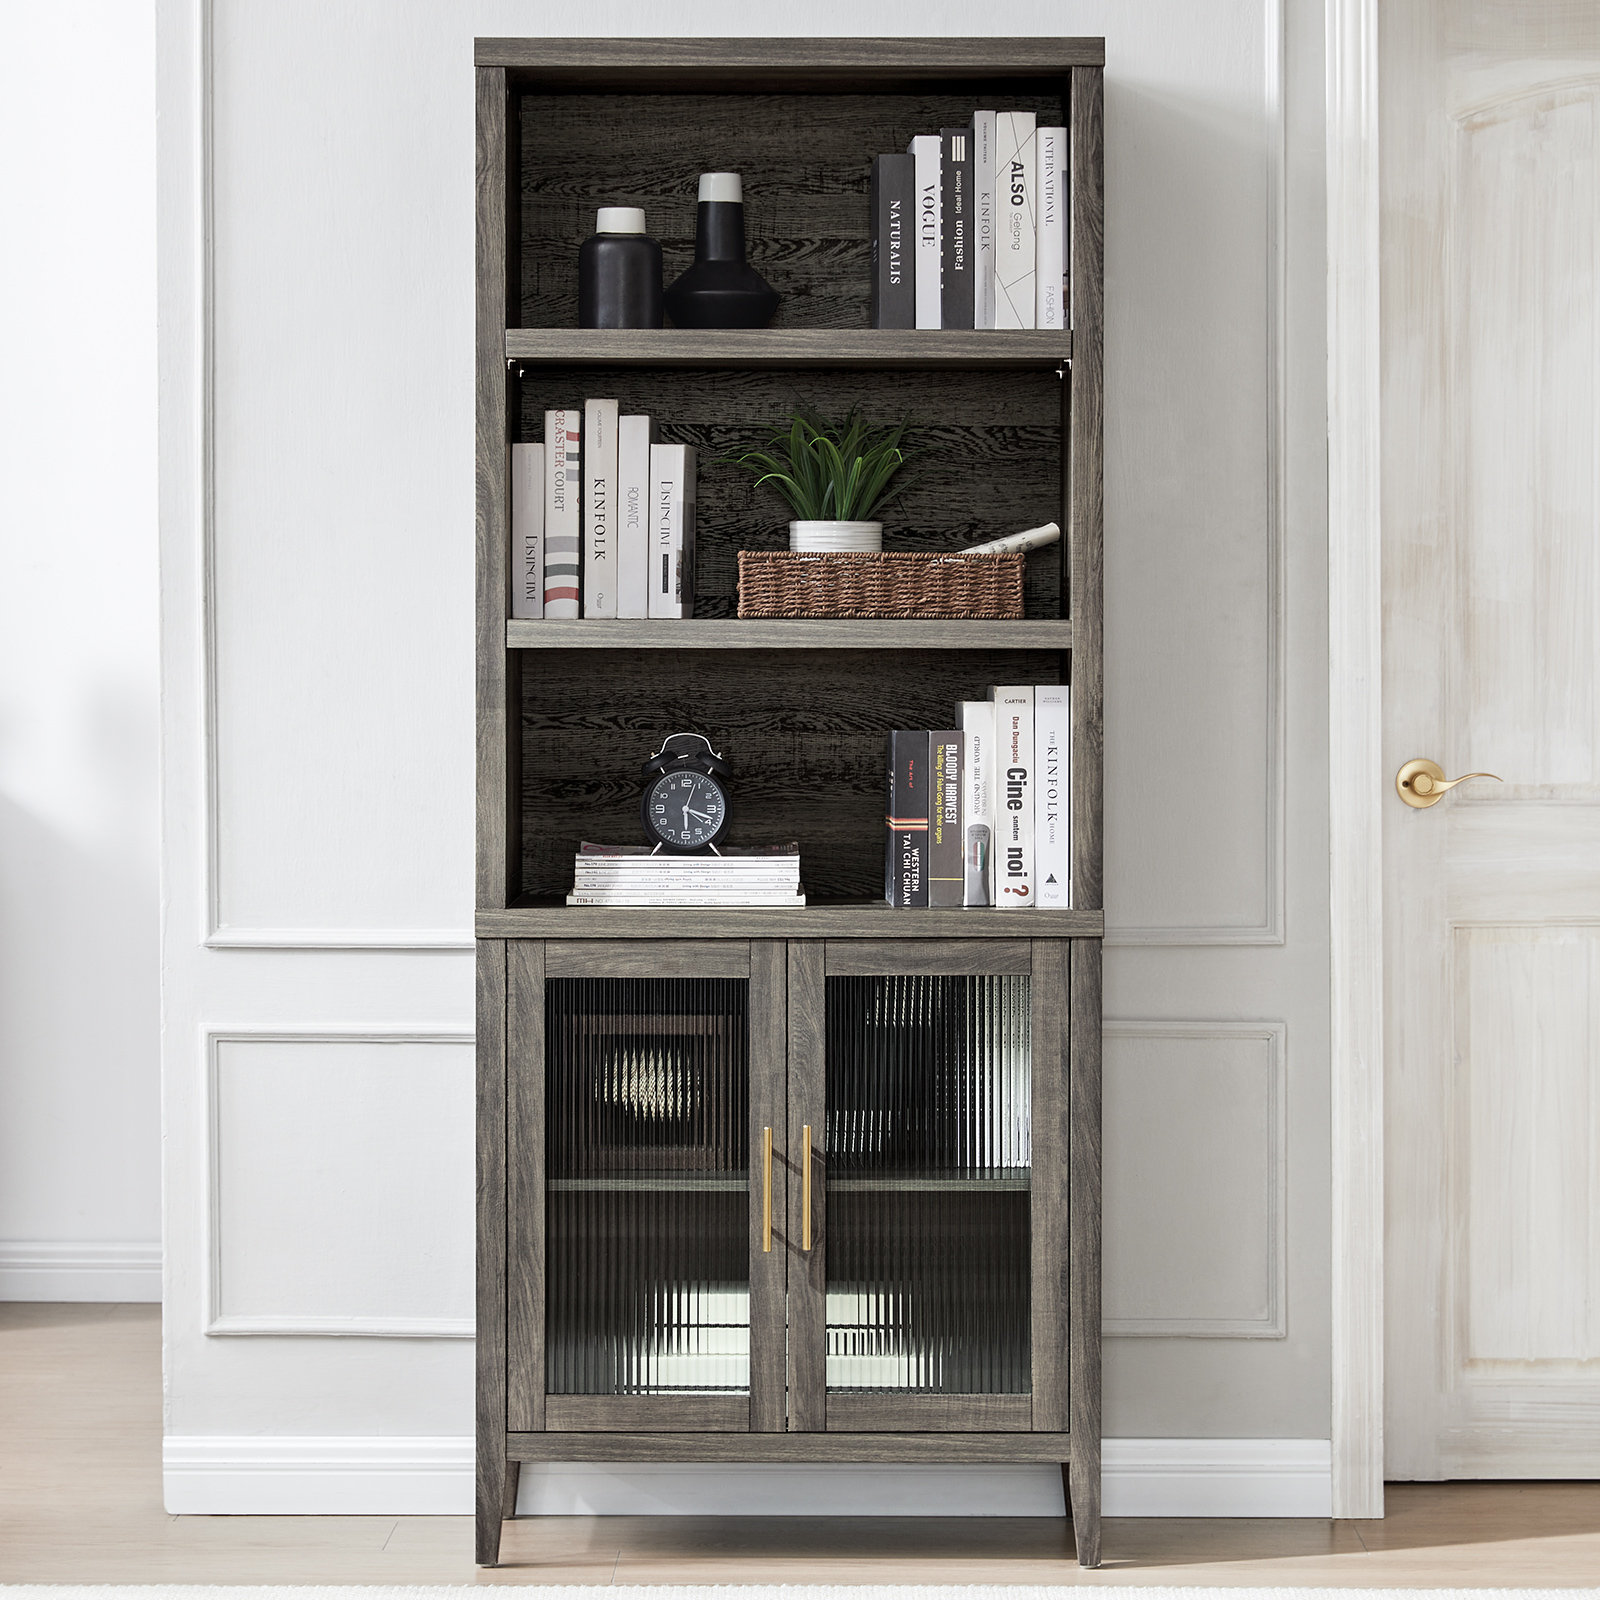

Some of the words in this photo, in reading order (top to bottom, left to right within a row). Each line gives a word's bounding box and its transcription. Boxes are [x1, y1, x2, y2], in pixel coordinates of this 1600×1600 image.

[1011, 161, 1024, 206] ALSO
[1045, 136, 1055, 227] INTERNATIONAL
[922, 184, 936, 247] VOGUE
[981, 192, 990, 251] KINFOLK
[1011, 213, 1023, 251] Gelang
[890, 200, 901, 285] NATURALIS
[954, 220, 964, 271] Fashion
[1046, 285, 1055, 325] FASHION
[554, 409, 565, 468] CRASTER
[554, 471, 565, 512] COURT
[627, 487, 640, 529] ROMANTIC
[593, 478, 606, 561] KINFOLK
[1012, 716, 1020, 730] Dan
[935, 754, 944, 770] killing
[936, 744, 944, 754] The
[945, 744, 957, 781] BLOODY
[973, 736, 981, 764] WORLD
[1011, 731, 1020, 764] Dungaciu
[681, 779, 692, 788] 12
[936, 778, 944, 792] Falun
[973, 766, 981, 781] THE
[1006, 767, 1027, 811] Cine
[1047, 746, 1058, 822] KINFOLK
[655, 804, 665, 814] 9
[705, 792, 712, 800] 2
[706, 804, 717, 814] 3
[934, 791, 944, 805] Gong
[936, 806, 944, 814] for
[945, 783, 957, 825] HARVEST
[973, 783, 981, 816] AROUND
[659, 817, 668, 825] 8
[681, 830, 691, 840] 6
[694, 827, 703, 835] 5
[903, 833, 911, 850] TAI
[903, 852, 911, 869] CHI
[911, 847, 920, 892] WESTERN
[1007, 846, 1028, 877] noi
[903, 872, 911, 905] CHUAN
